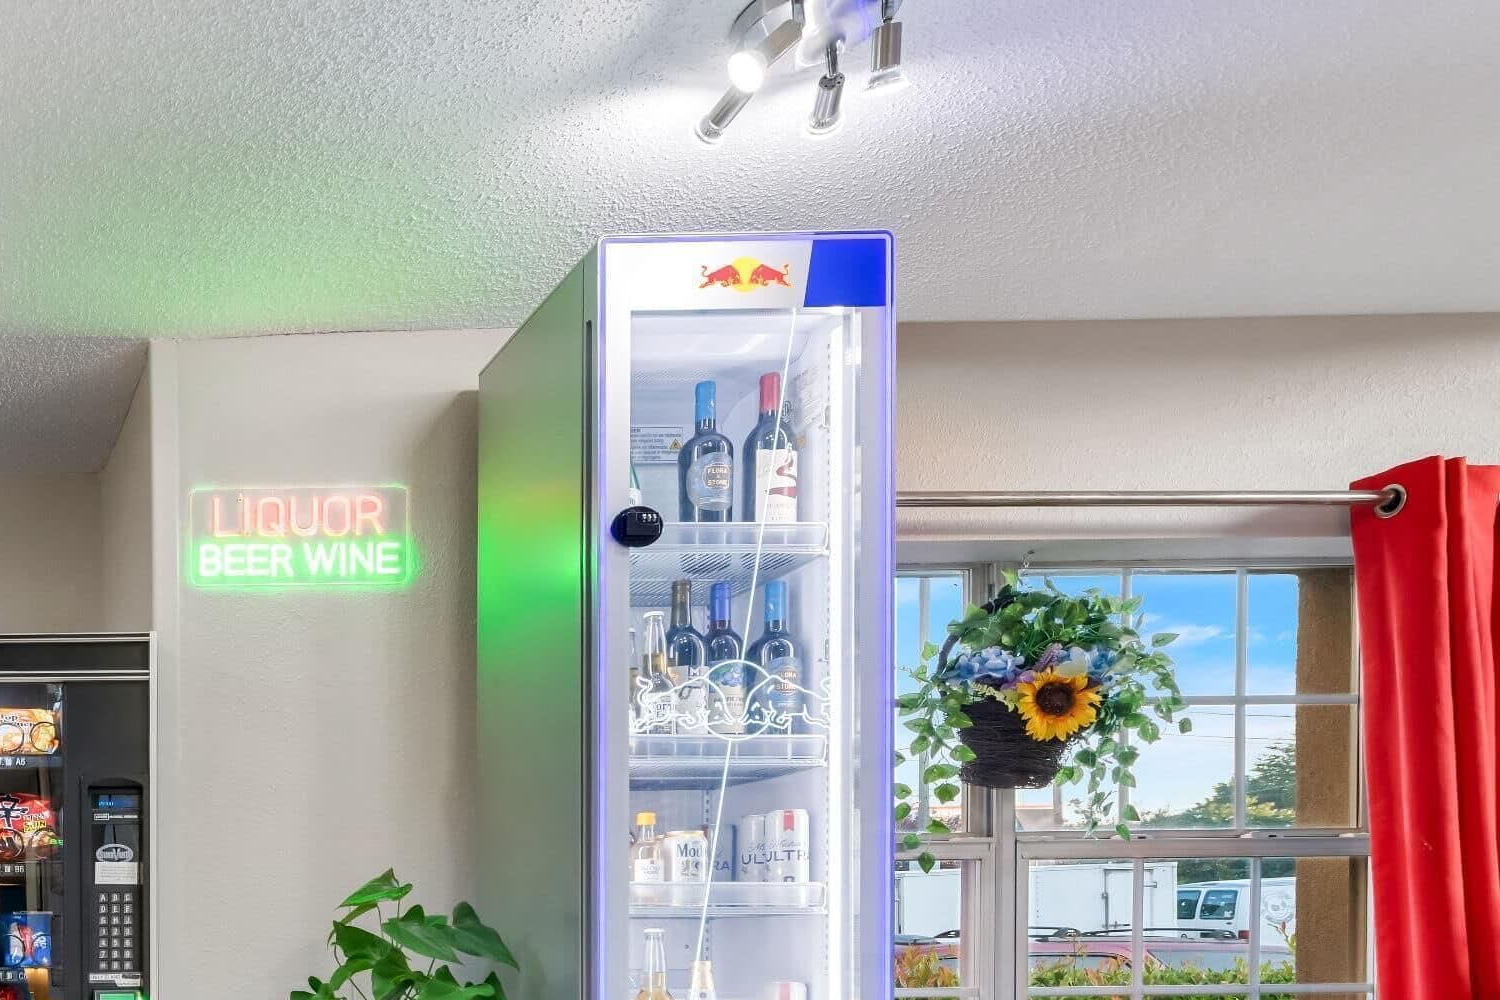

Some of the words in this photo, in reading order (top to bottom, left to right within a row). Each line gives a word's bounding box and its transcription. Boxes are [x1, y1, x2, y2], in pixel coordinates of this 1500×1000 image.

[213, 496, 387, 537] LIQUOR
[199, 543, 294, 577] BEER
[303, 541, 403, 576] WINE
